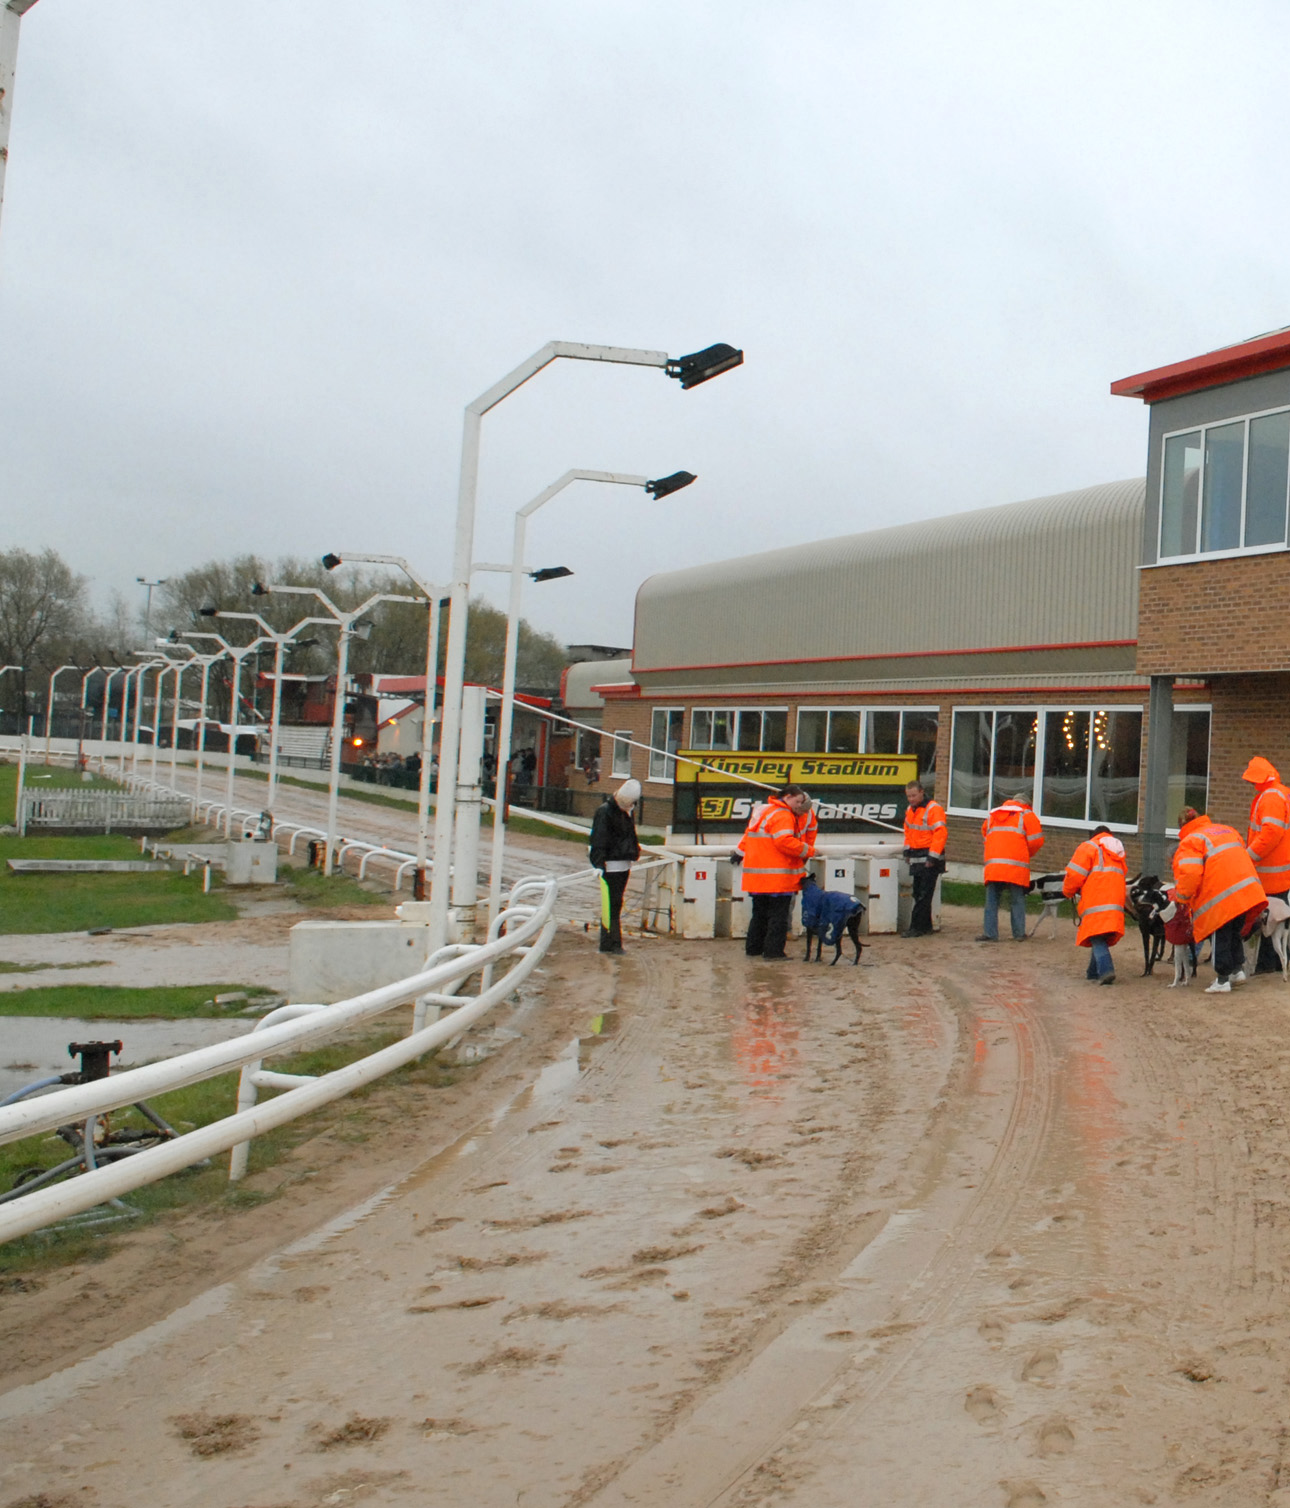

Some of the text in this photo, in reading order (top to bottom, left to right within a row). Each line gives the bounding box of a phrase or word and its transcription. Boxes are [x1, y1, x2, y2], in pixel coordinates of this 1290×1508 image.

[699, 758, 899, 779] Kinsley Stadium
[825, 922, 834, 940] 2
